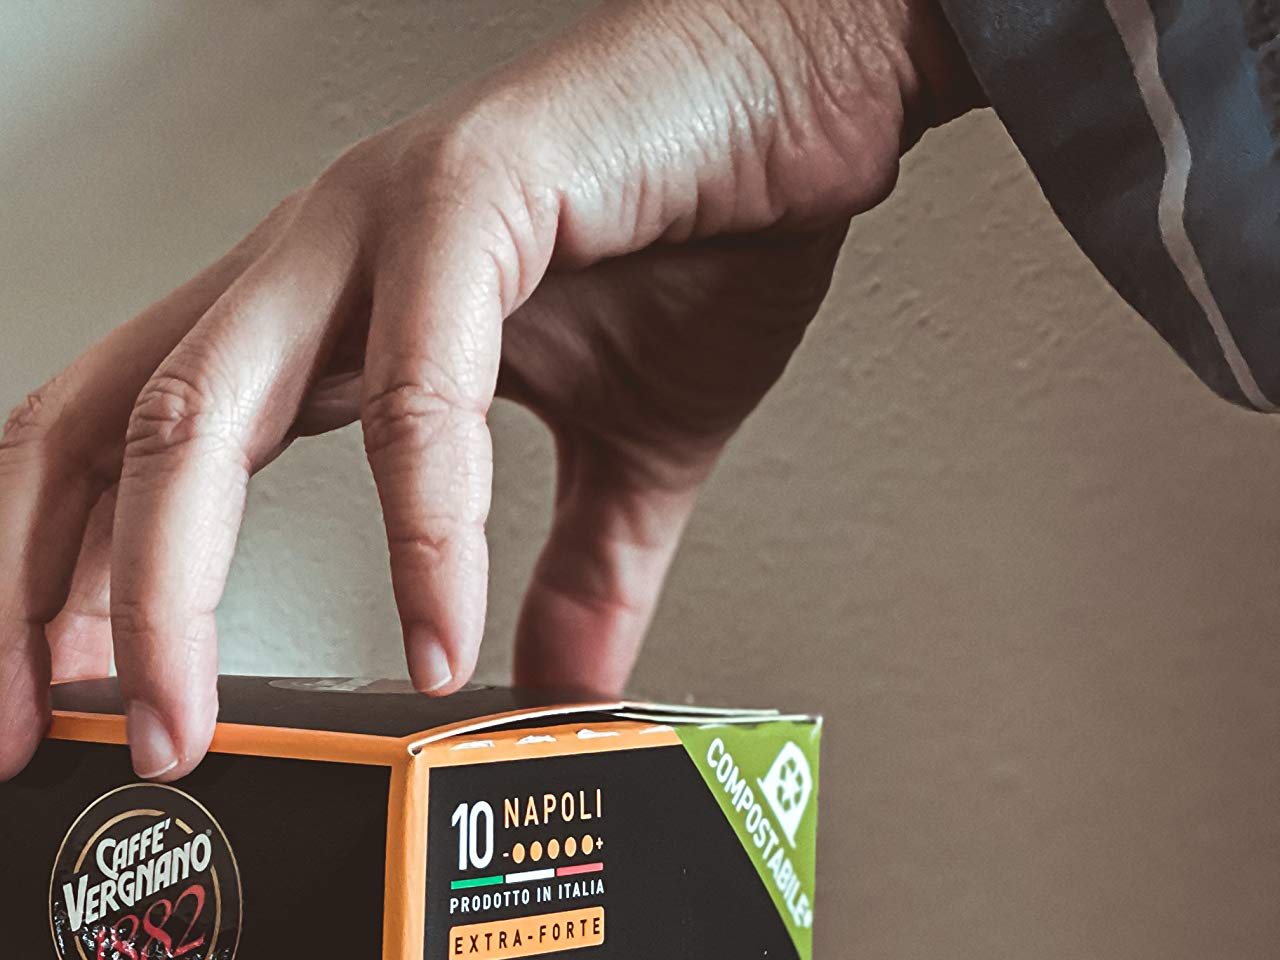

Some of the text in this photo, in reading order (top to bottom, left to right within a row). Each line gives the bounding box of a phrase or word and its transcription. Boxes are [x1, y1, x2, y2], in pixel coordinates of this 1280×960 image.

[451, 788, 603, 870] 10 NAPOLI
[63, 833, 212, 932] VERGNANO
[450, 879, 604, 914] PRODOTTO IN ITALIA
[454, 917, 601, 955] EXTRA-FORTE
